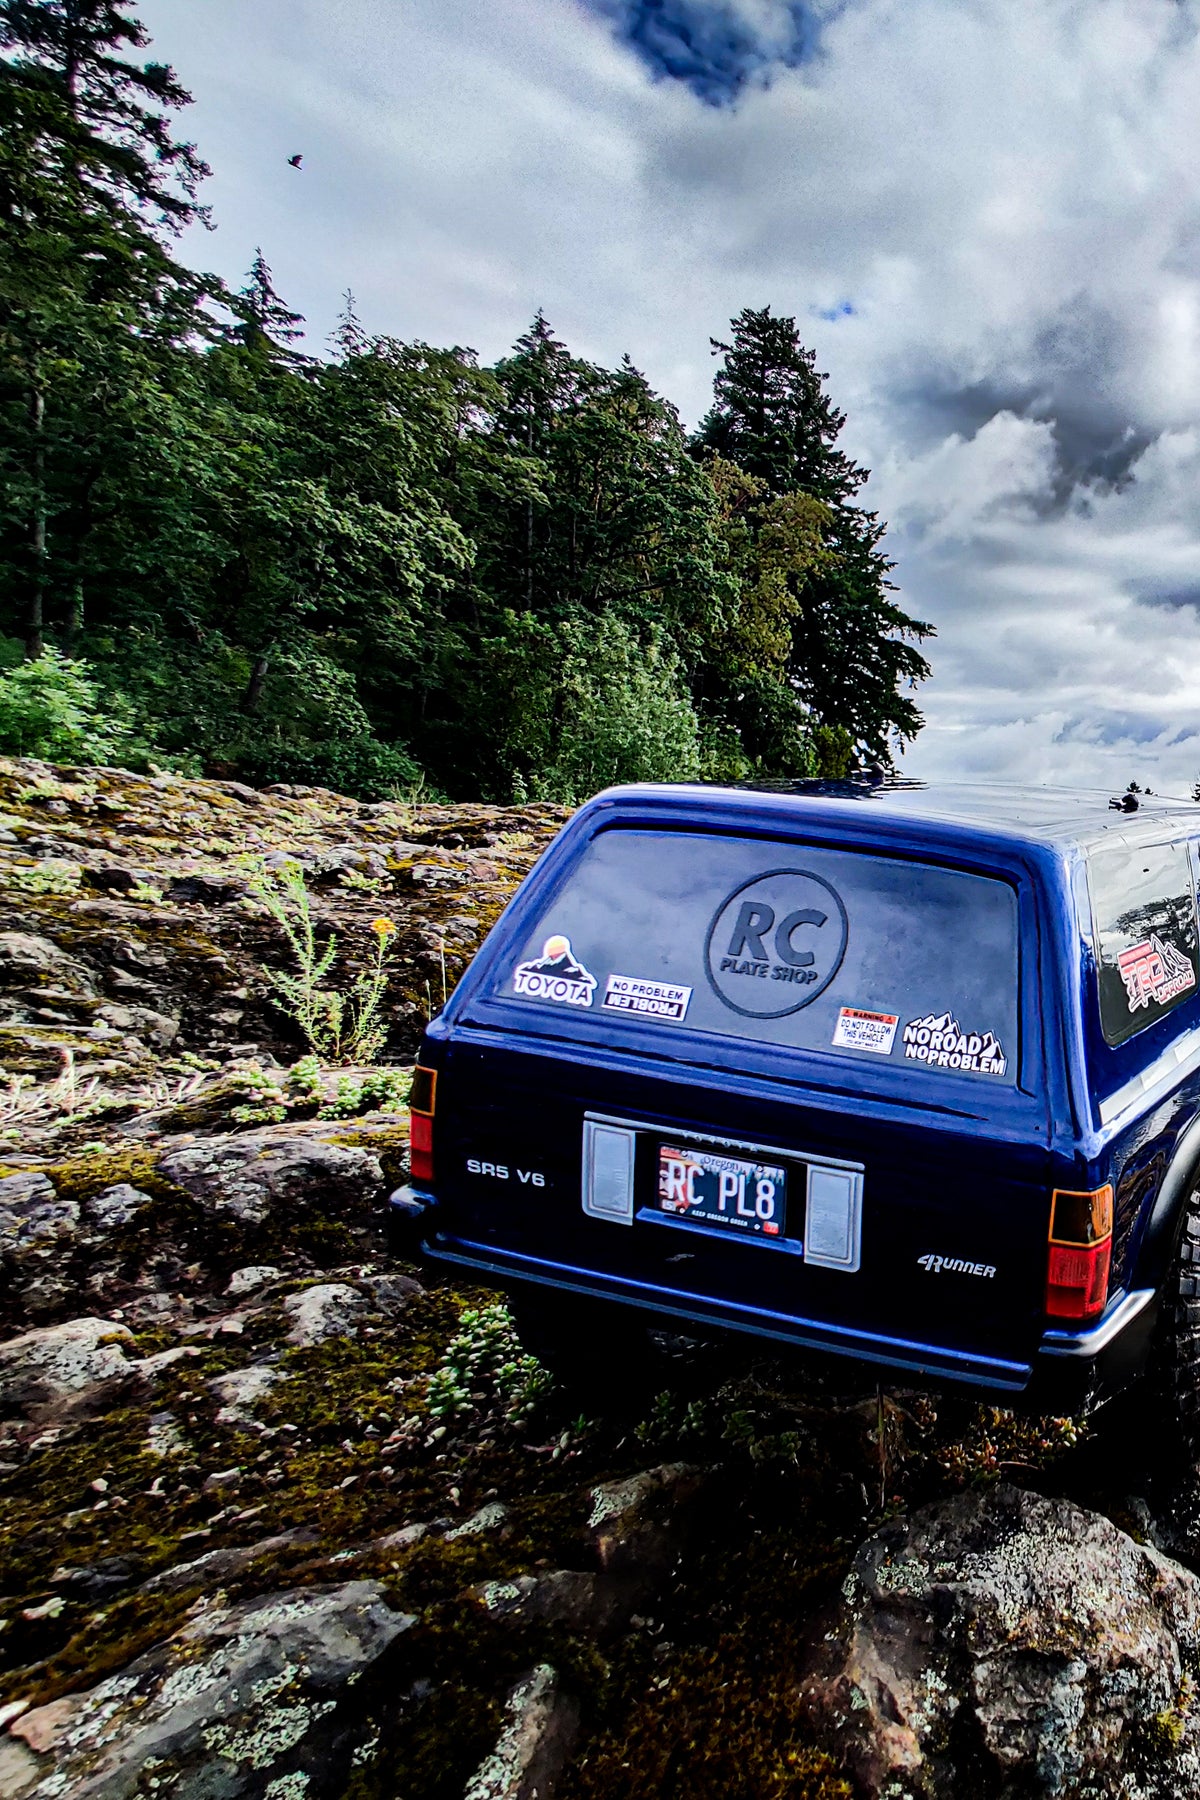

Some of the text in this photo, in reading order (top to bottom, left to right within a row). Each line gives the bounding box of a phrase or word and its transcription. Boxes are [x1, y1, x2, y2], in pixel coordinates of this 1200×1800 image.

[727, 901, 829, 968] RC
[719, 957, 819, 985] PLATE SHOP
[1120, 952, 1165, 1010] TRD
[517, 973, 590, 1002] TOYOTA
[613, 981, 684, 1000] NO PROBLEM
[607, 993, 680, 1016] PROBLEM
[853, 1011, 885, 1022] WARNING
[841, 1018, 893, 1035] DO NOT FOLLOW
[843, 1028, 885, 1043] THIS VEHICLE
[466, 1159, 546, 1187] SR5 V6
[703, 1155, 740, 1172] Oregon
[667, 1159, 776, 1220] RC PL8
[917, 1254, 997, 1278] 4RUNNER
